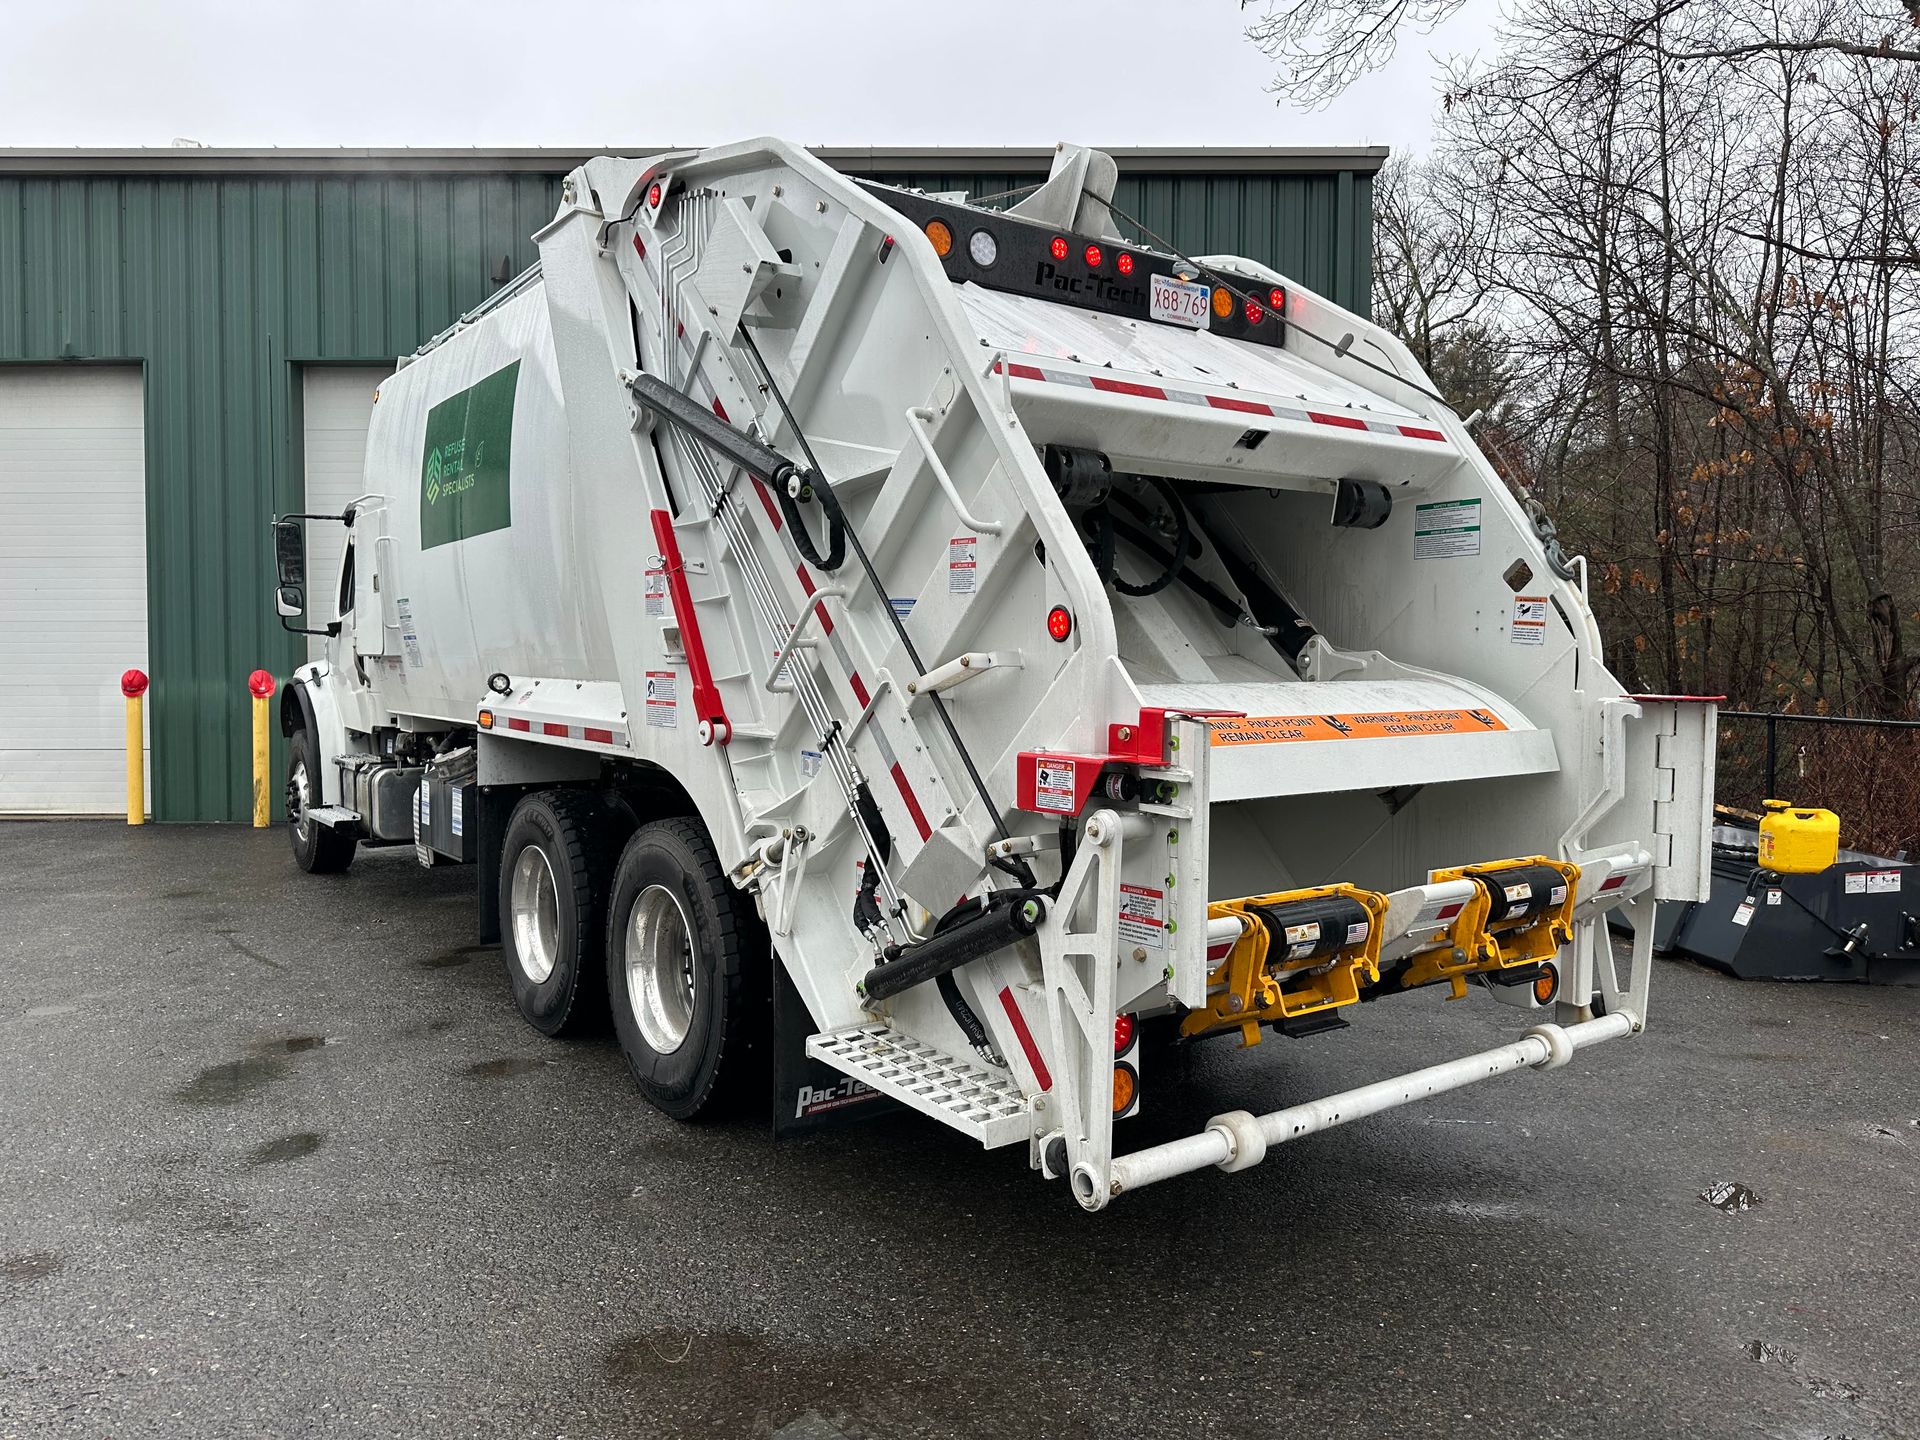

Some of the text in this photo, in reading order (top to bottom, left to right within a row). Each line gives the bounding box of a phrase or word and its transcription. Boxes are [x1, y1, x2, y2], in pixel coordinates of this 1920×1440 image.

[1035, 261, 1147, 305] Pac-Tech
[1166, 313, 1194, 323] COMMERCIAL
[444, 438, 466, 458] REFUSE
[443, 458, 464, 476] RENTAL
[442, 473, 475, 497] SPECIALISTS
[1246, 719, 1283, 729] PINCH
[1282, 718, 1318, 727] POINT
[1352, 714, 1401, 724] WARNING
[1405, 713, 1438, 722] PINCH
[1437, 711, 1465, 721] POINT
[1383, 722, 1457, 734] REMAIN CLEAR
[1218, 729, 1306, 742] REMAIN CLEAR
[1046, 762, 1065, 770] DANGER
